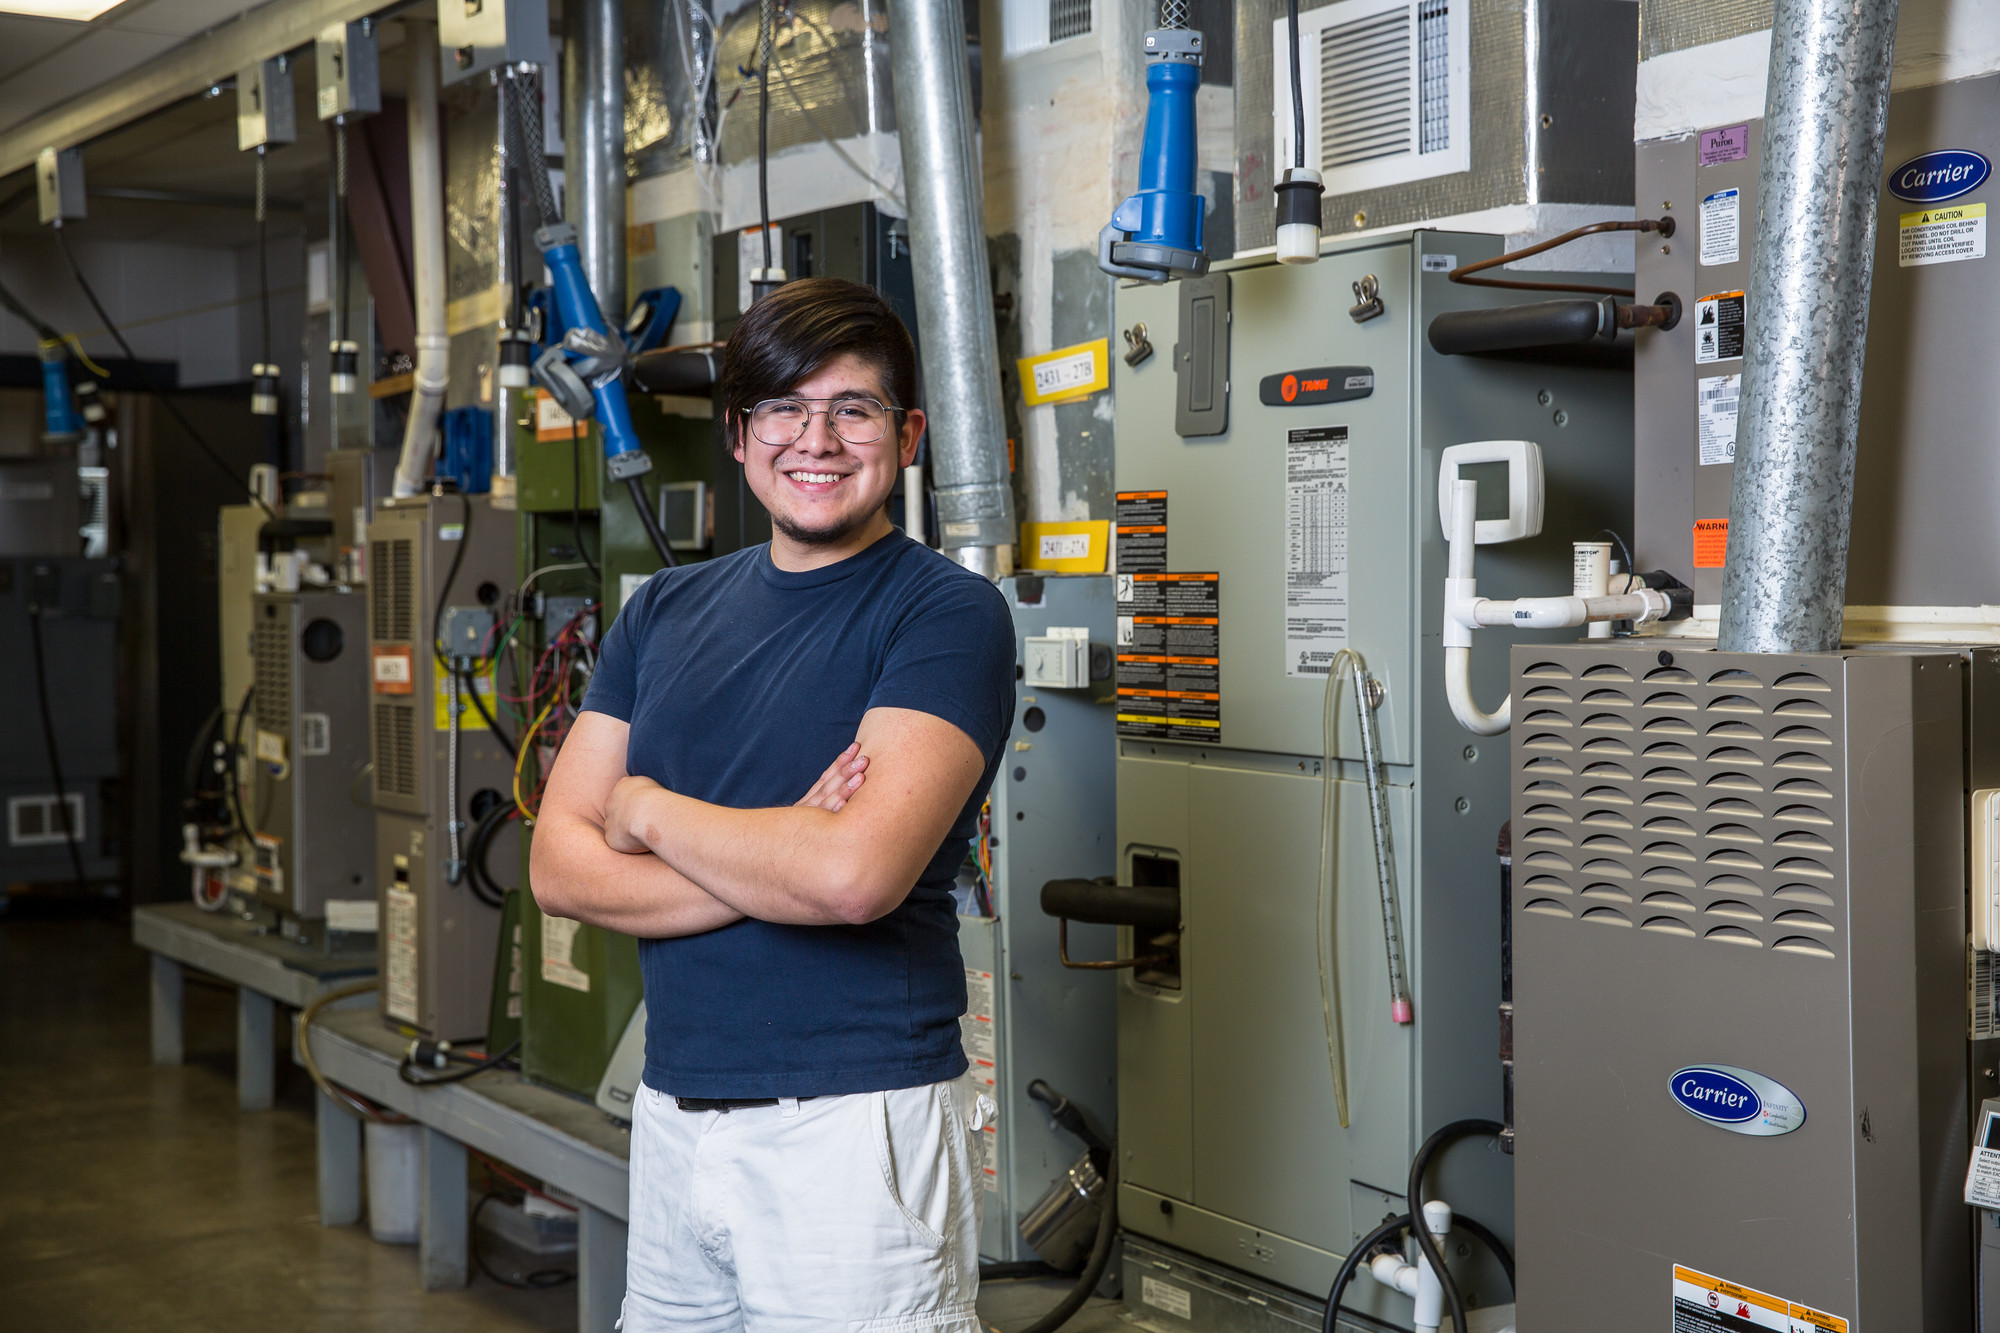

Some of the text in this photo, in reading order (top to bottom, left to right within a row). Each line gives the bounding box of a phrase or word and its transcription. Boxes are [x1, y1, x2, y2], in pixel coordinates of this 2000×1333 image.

[1711, 138, 1733, 149] Puron
[1901, 163, 1974, 189] Carrier
[1934, 210, 1963, 221] CAUTION
[1911, 224, 1945, 233] CONDITIONING
[1959, 220, 1979, 228] BEHIND
[1950, 228, 1965, 236] DRILL
[1901, 246, 1926, 254] LOCATION
[1937, 242, 1951, 250] BEEN
[1951, 240, 1975, 248] VERIFIED
[1909, 252, 1934, 260] REMOVING
[1934, 249, 1955, 257] ACCESS
[1956, 246, 1974, 254] COVER
[1300, 378, 1329, 392] TRANE
[1681, 1079, 1748, 1108] Carrier
